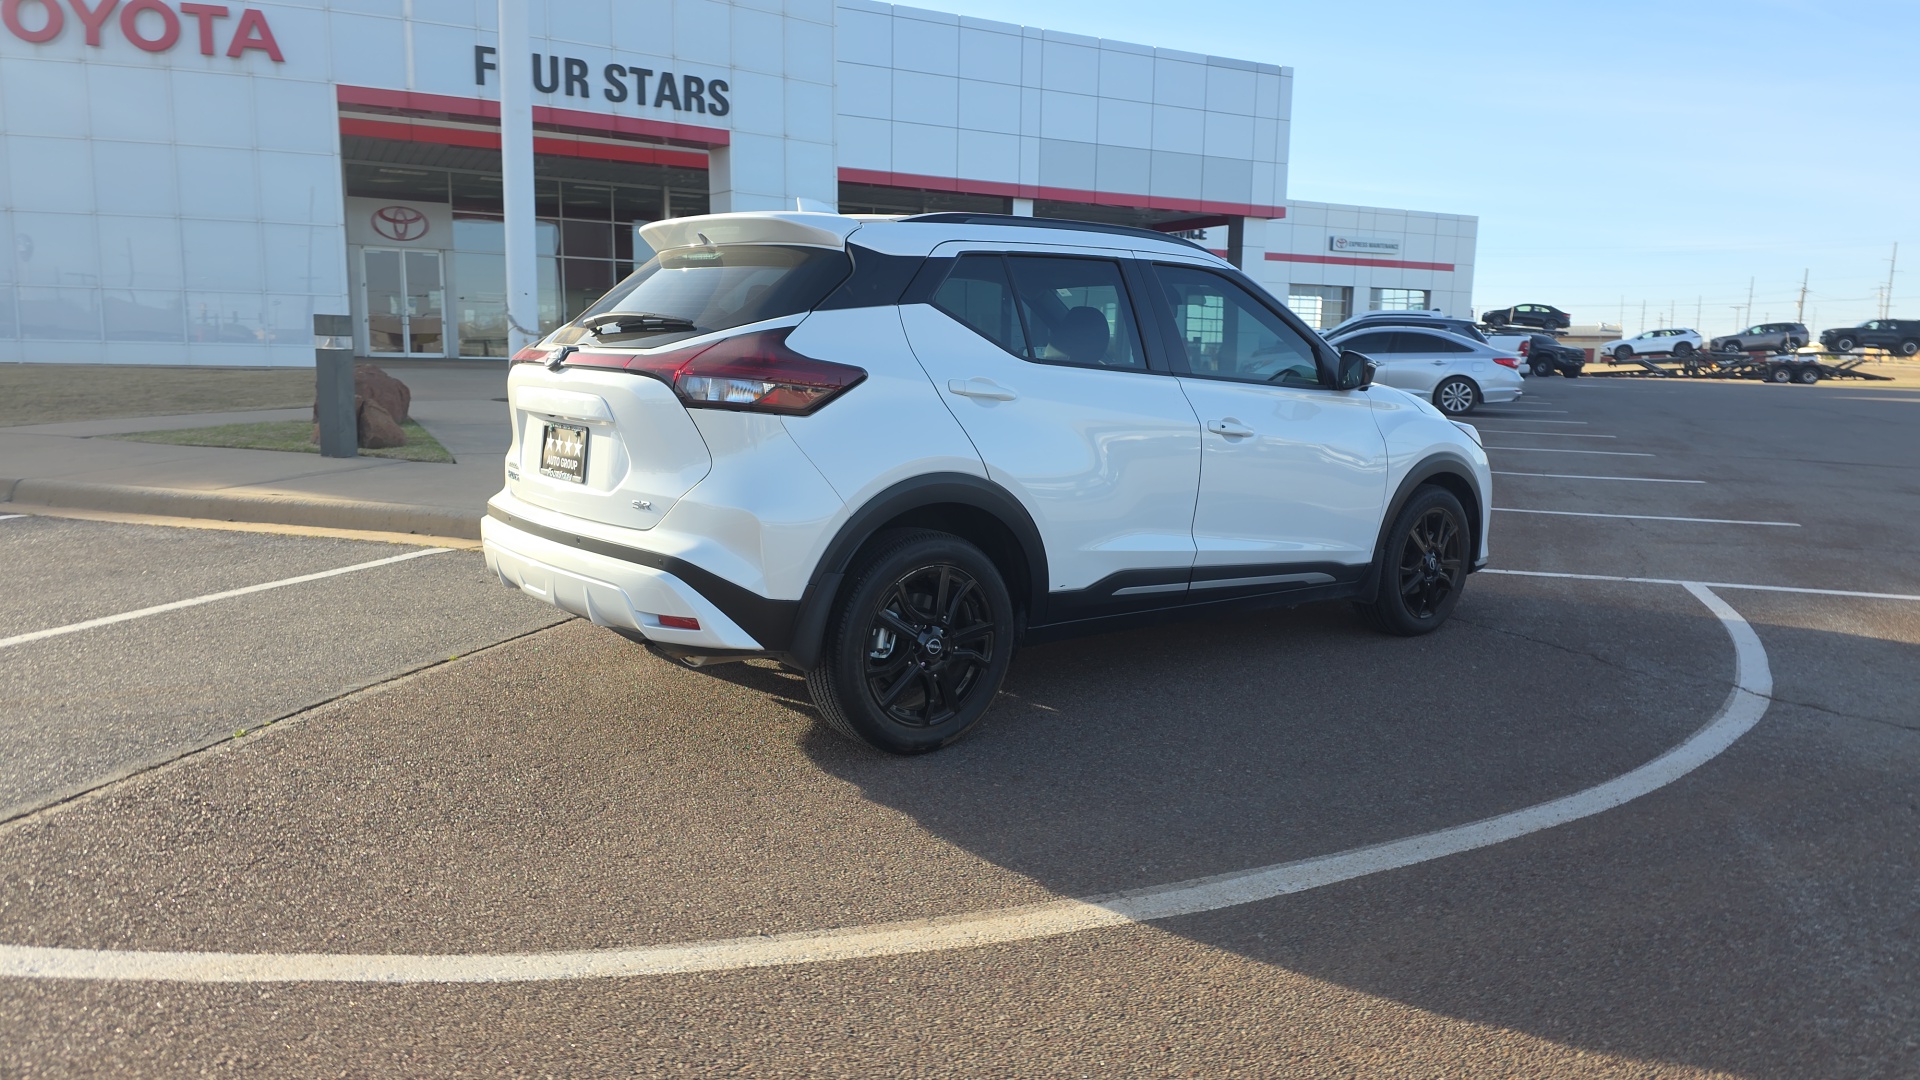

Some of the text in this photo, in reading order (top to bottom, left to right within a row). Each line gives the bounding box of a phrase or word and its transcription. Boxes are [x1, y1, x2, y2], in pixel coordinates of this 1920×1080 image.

[474, 45, 730, 116] FUR STARS
[1348, 240, 1368, 248] EXPRESS
[546, 455, 578, 470] AUTO GROUP
